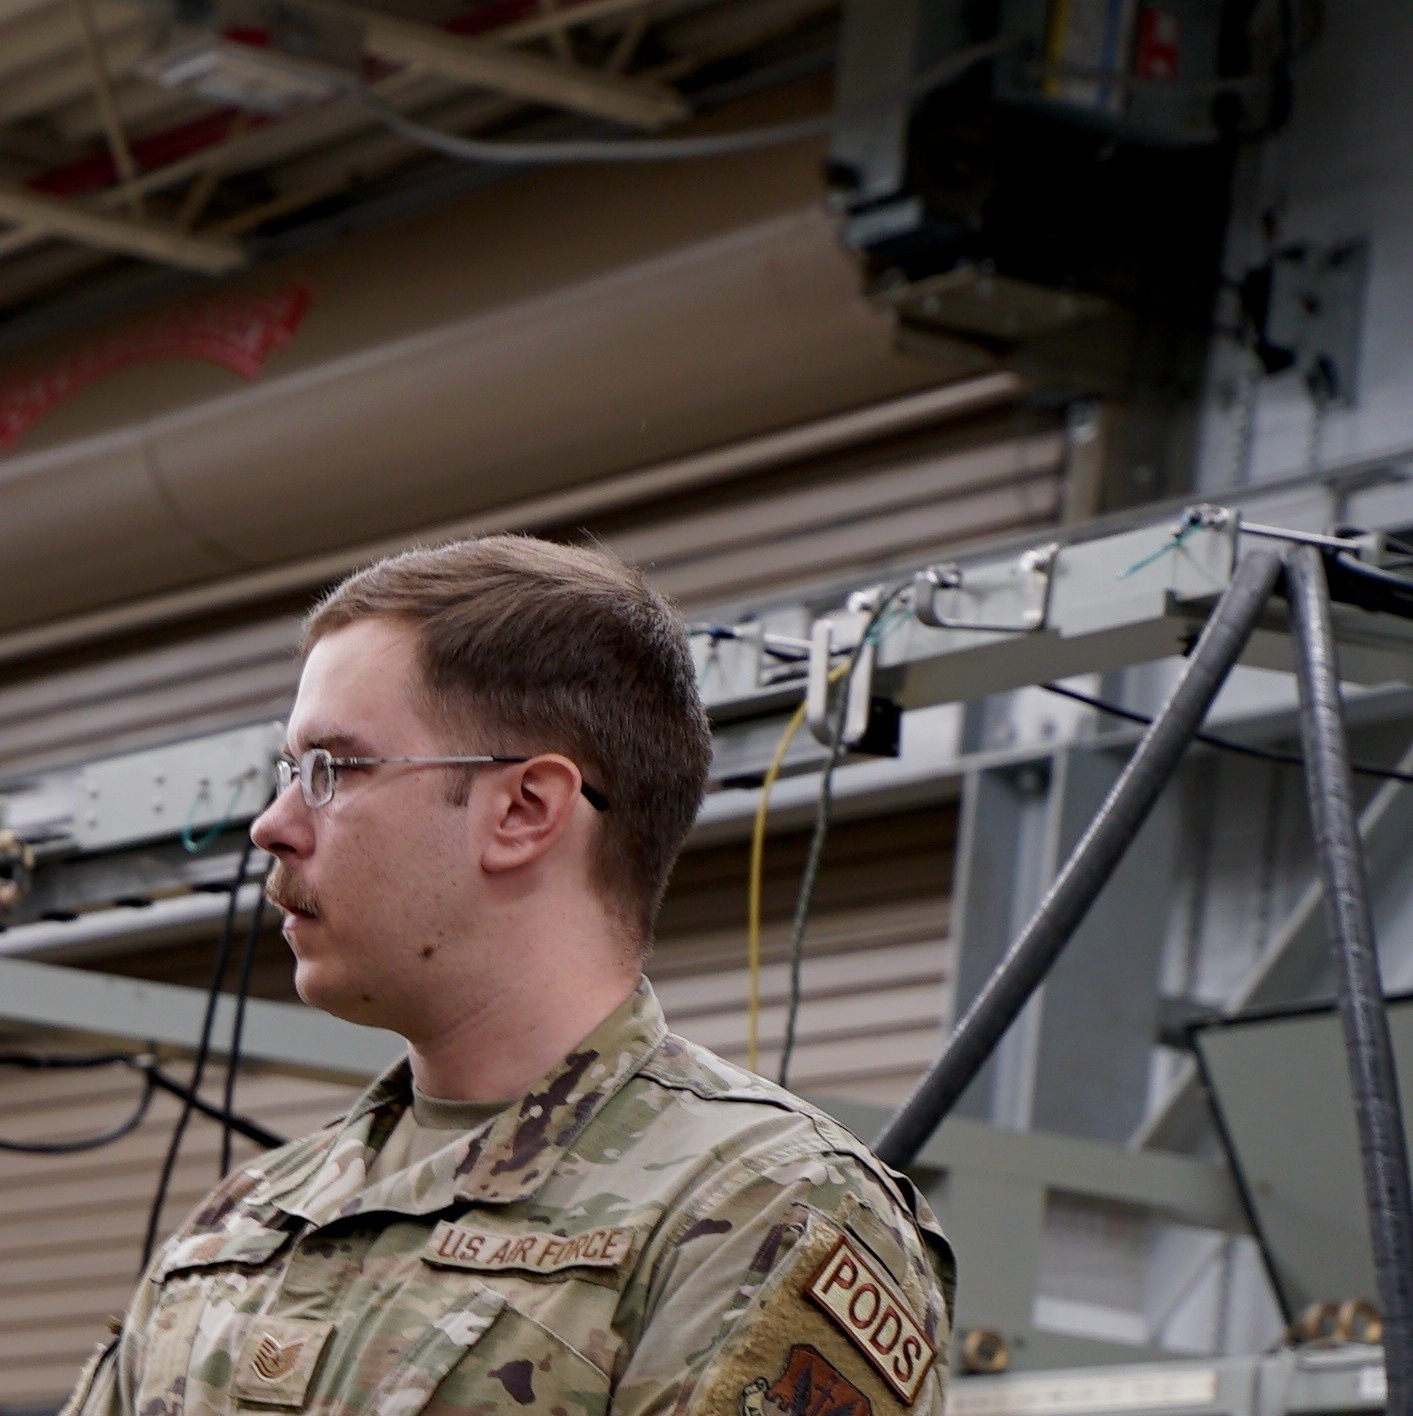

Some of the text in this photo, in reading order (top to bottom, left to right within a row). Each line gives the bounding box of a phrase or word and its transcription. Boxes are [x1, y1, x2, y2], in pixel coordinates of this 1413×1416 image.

[486, 1235, 538, 1265] AIR
[534, 1228, 623, 1267] FORCE
[821, 1253, 922, 1383] PODS
